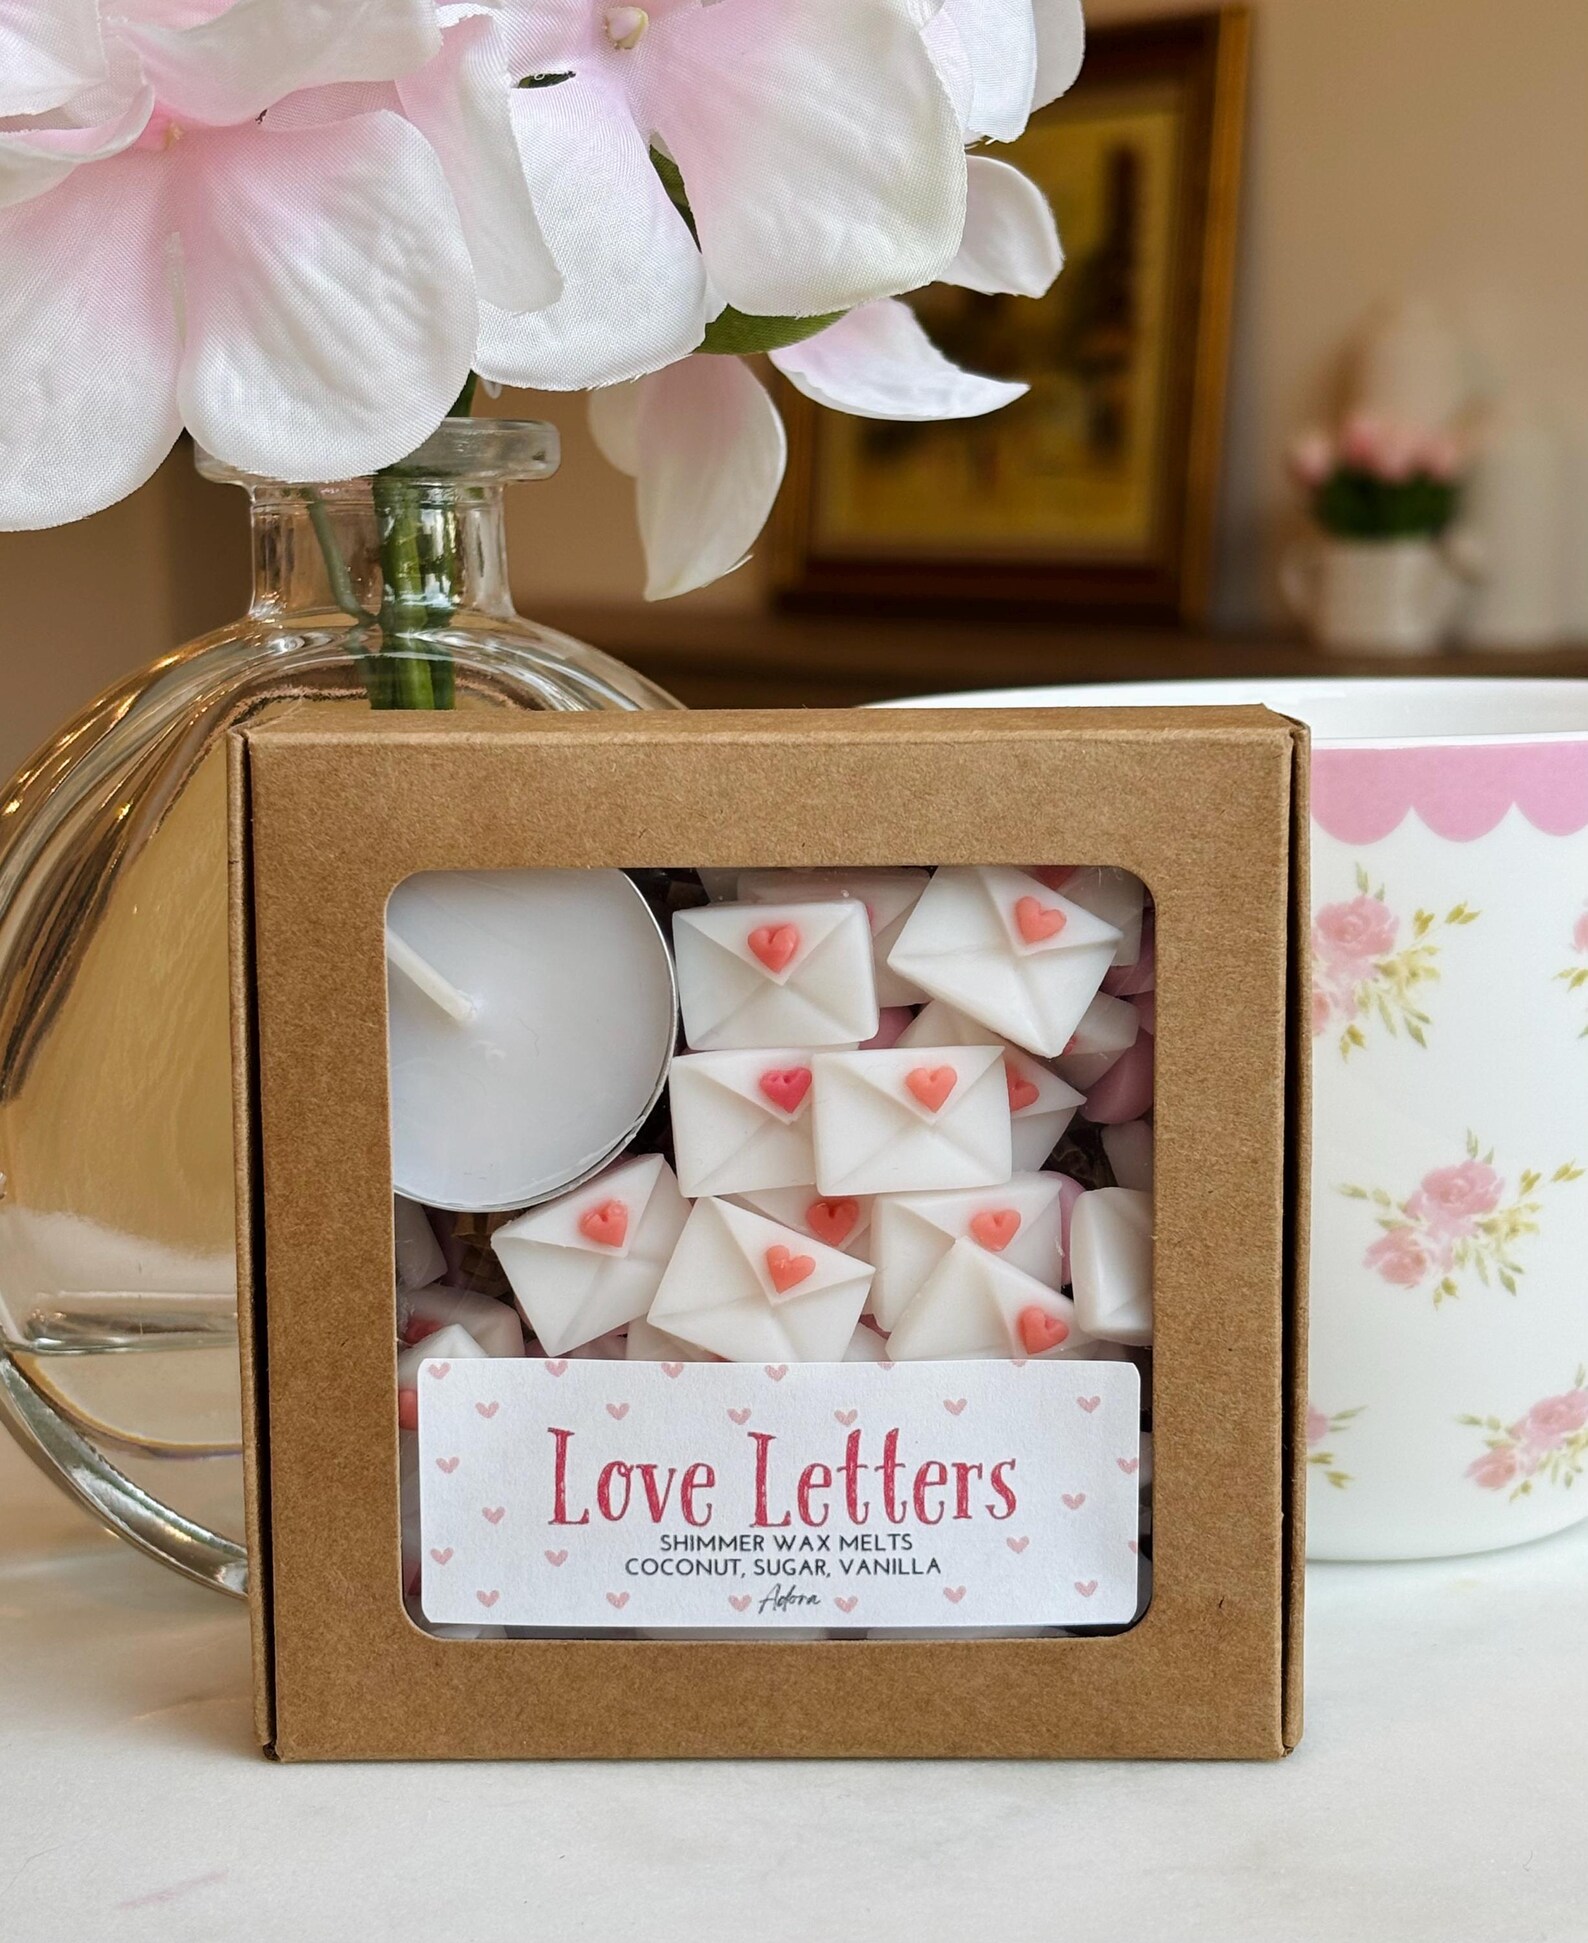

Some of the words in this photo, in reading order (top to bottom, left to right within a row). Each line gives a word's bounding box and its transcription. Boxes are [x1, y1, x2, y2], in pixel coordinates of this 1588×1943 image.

[547, 1427, 715, 1526] Love
[747, 1427, 1018, 1528] Letters
[660, 1533, 765, 1552] SHIMMER
[772, 1533, 831, 1551] WAX
[838, 1533, 913, 1551] MELTS
[624, 1557, 746, 1579] COCONUT,
[752, 1557, 832, 1578] SUGAR,
[838, 1557, 942, 1576] VANILLA
